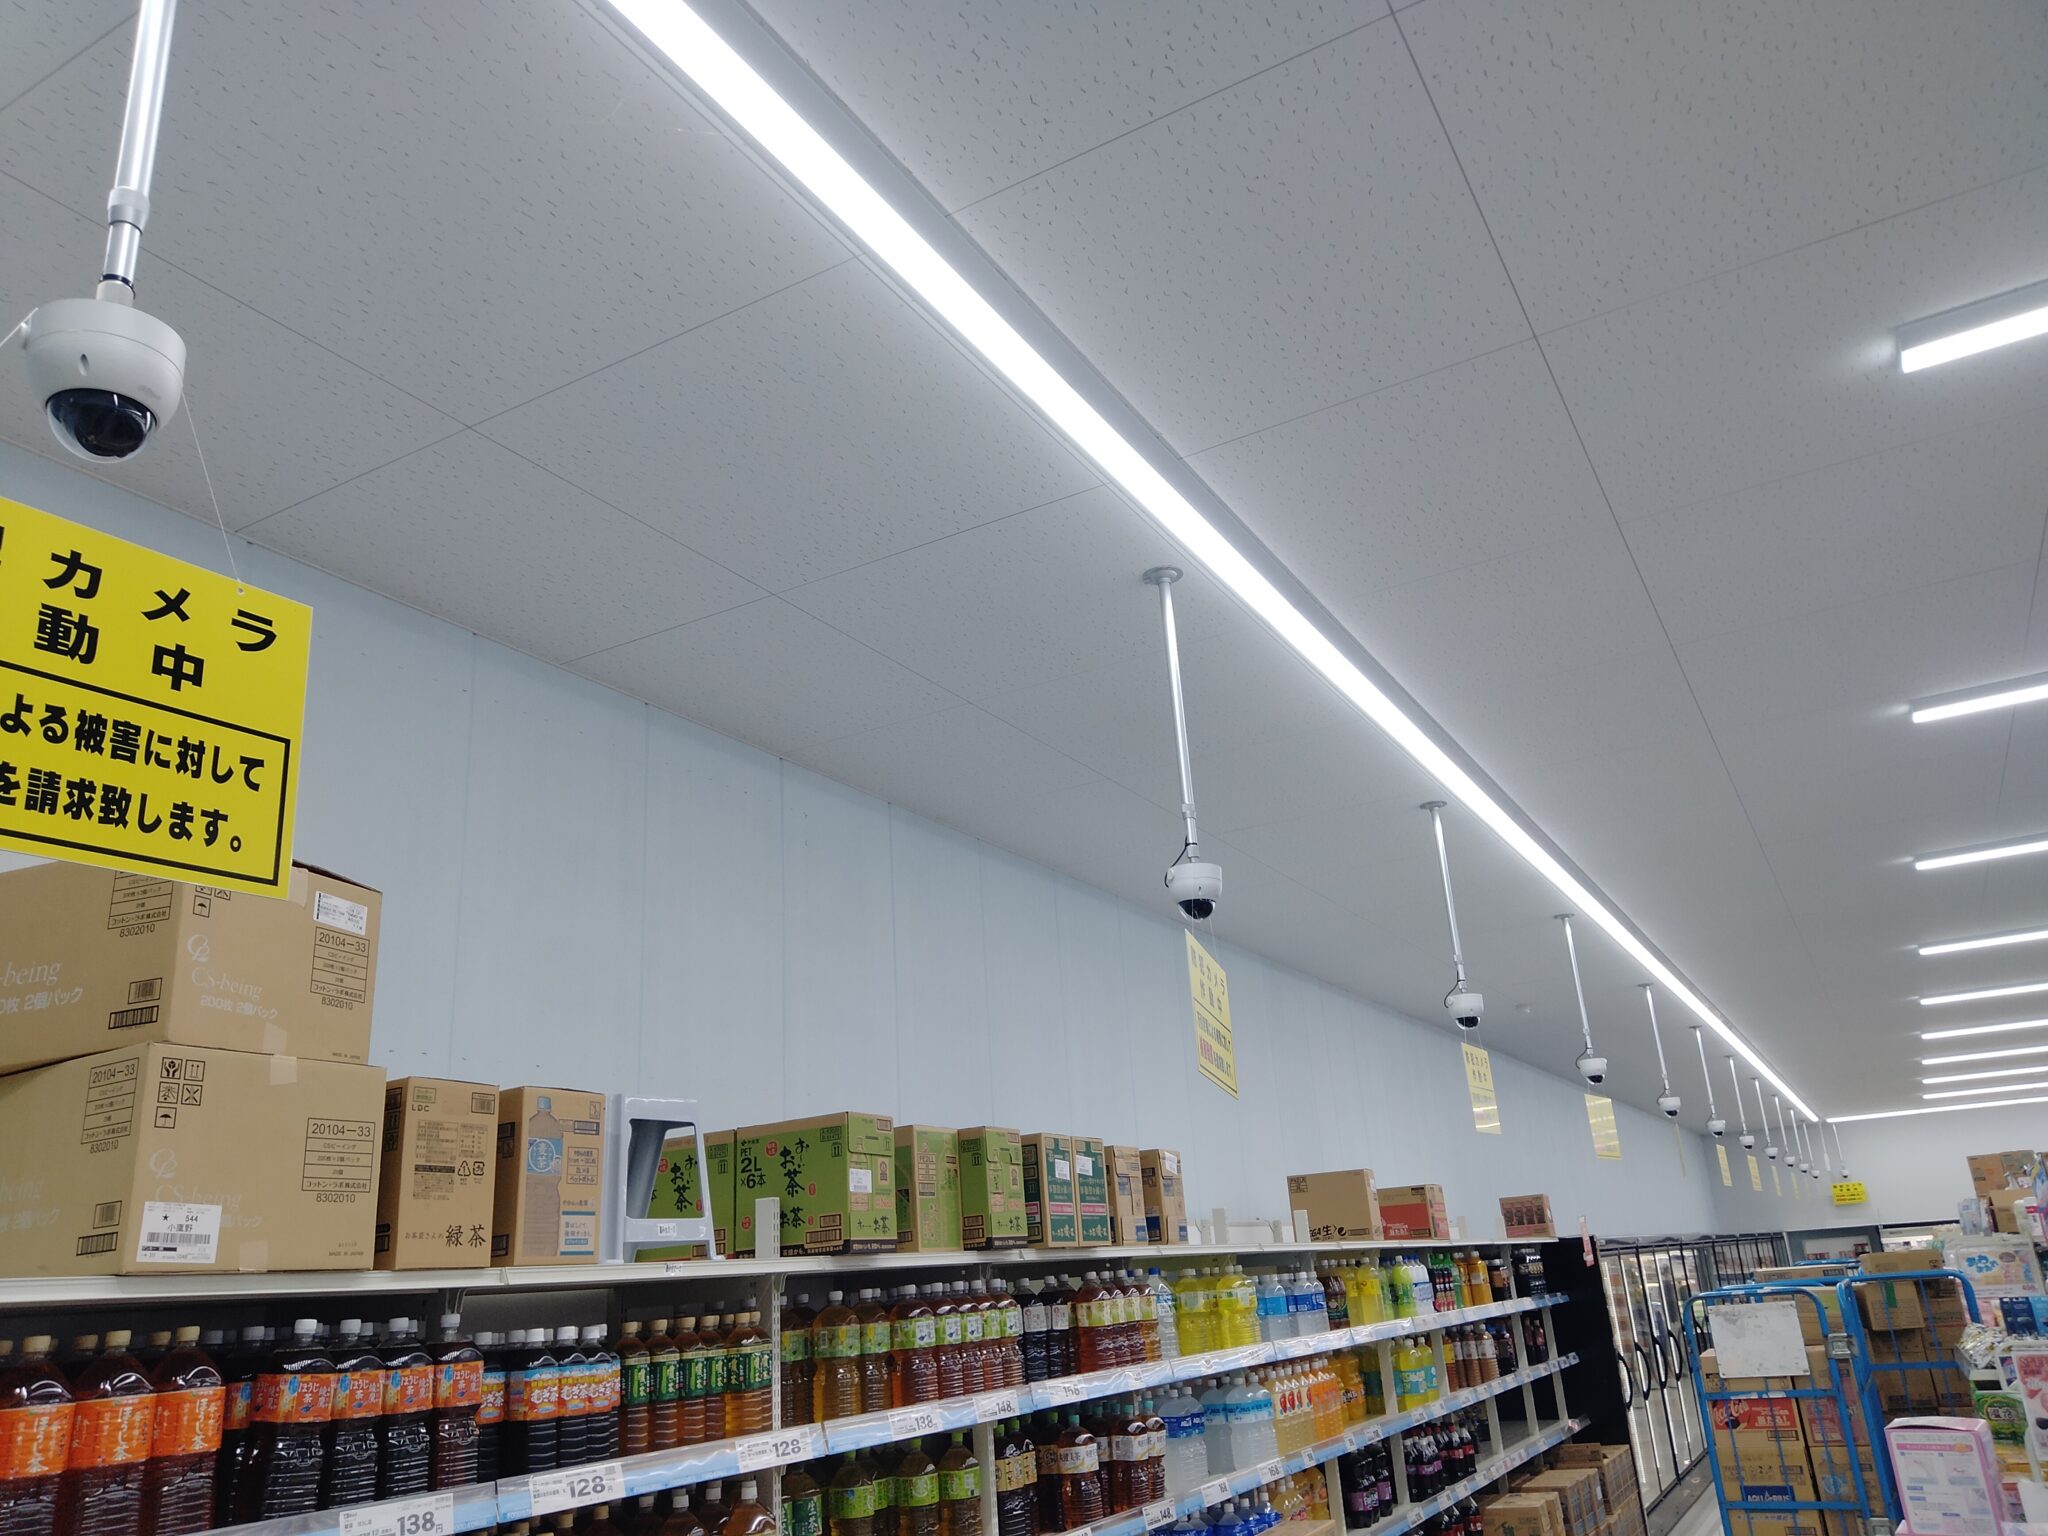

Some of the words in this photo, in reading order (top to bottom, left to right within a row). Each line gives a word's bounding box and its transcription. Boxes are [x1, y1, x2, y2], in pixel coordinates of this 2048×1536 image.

[0, 524, 278, 652] カメラ
[33, 602, 205, 692] 動中
[0, 692, 266, 793] よる被害に対して
[0, 760, 243, 853] を請求致します。
[119, 923, 156, 938] 8302010
[321, 996, 354, 1010] 8302010
[411, 1104, 430, 1112] LDC
[740, 1148, 752, 1157] PET
[740, 1156, 762, 1173] 2L
[779, 1145, 805, 1198] お茶
[670, 1162, 693, 1213] お茶
[316, 1192, 356, 1203] 8302010
[184, 1214, 199, 1223] 544
[445, 1223, 487, 1248] 緑茶
[406, 1385, 415, 1395] 茶
[457, 1380, 466, 1390] 茶
[303, 1393, 313, 1403] 茶
[354, 1390, 364, 1400] 茶
[772, 1438, 801, 1458] 128
[566, 1475, 606, 1499] 128
[396, 1511, 436, 1536] 138
